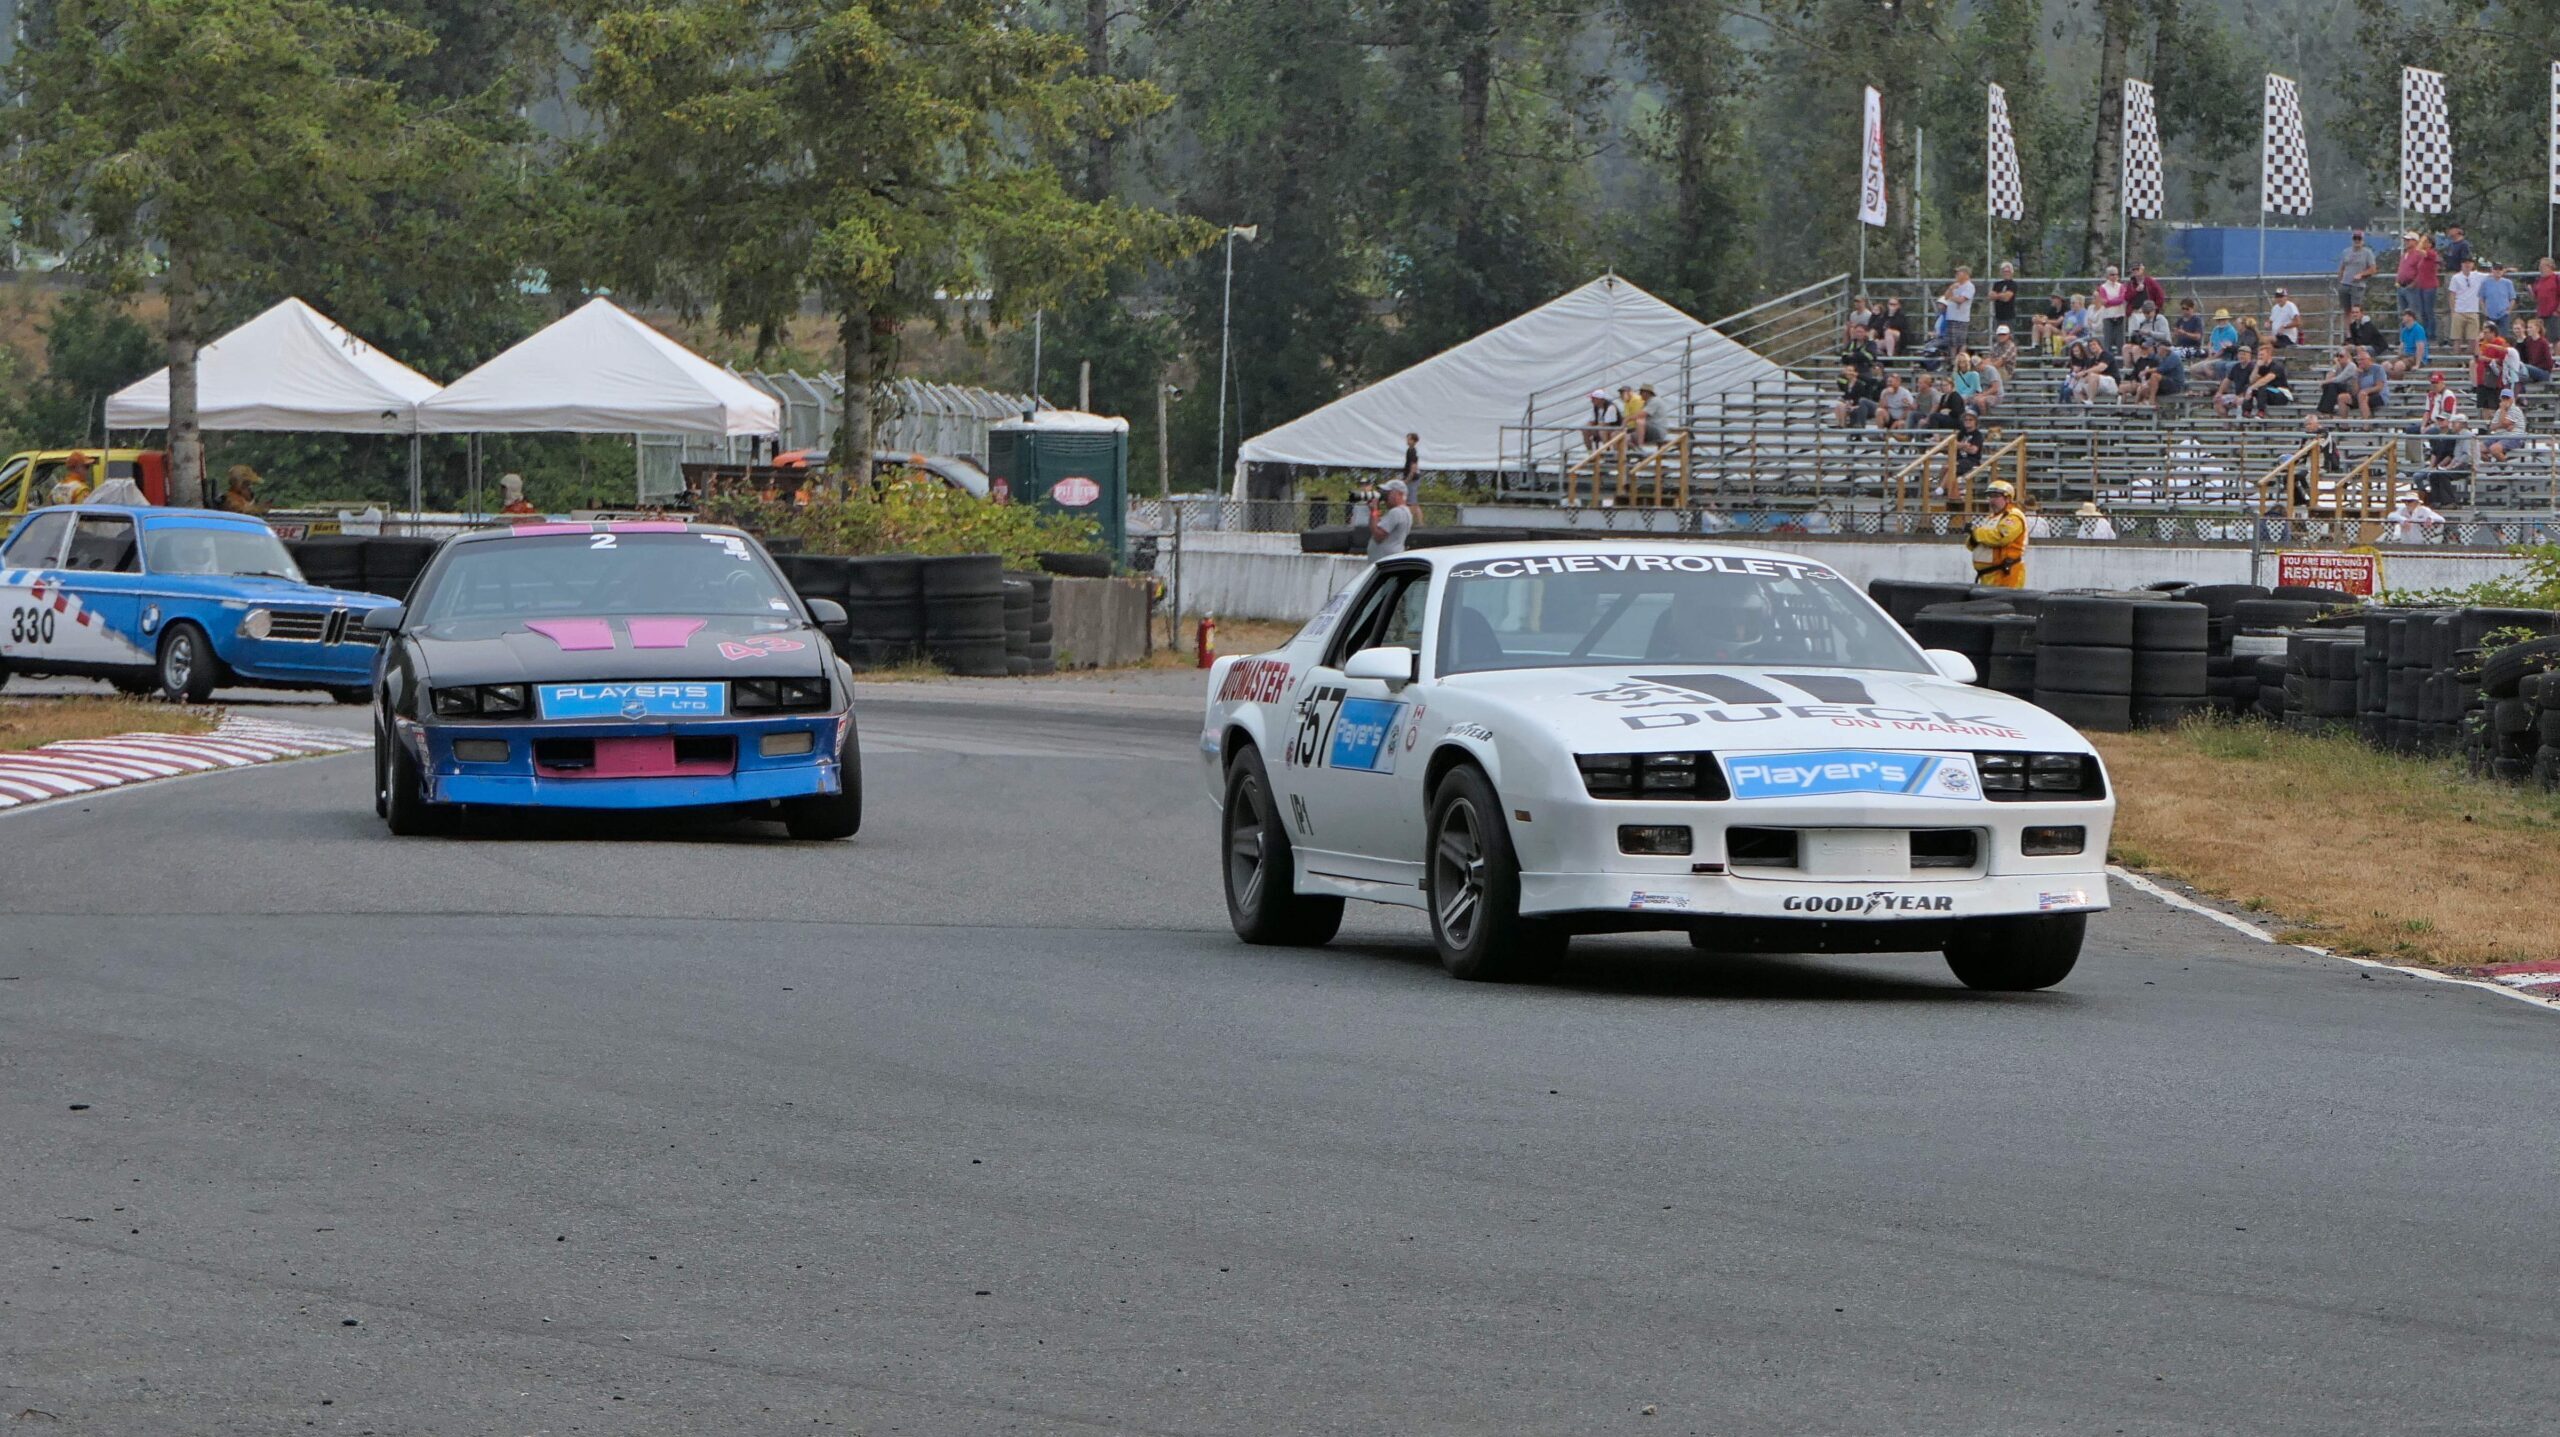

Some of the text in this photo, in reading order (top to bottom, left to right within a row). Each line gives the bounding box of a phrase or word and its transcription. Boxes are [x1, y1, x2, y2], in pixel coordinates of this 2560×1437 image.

[590, 534, 617, 549] 2
[1482, 555, 1808, 580] CHEVROLET
[2283, 557, 2300, 565] YOU
[2321, 558, 2361, 567] ENTERING
[2363, 559, 2370, 567] A
[2284, 566, 2368, 580] RESTRICTED
[11, 606, 55, 644] 330
[717, 636, 805, 661] 43
[556, 685, 708, 700] PLAYER'S
[1294, 685, 1348, 768] 157
[1619, 704, 2017, 731] DUECK
[1832, 717, 2028, 740] ON MARINE
[1338, 717, 1383, 752] Player's
[1733, 761, 1907, 788] Player's
